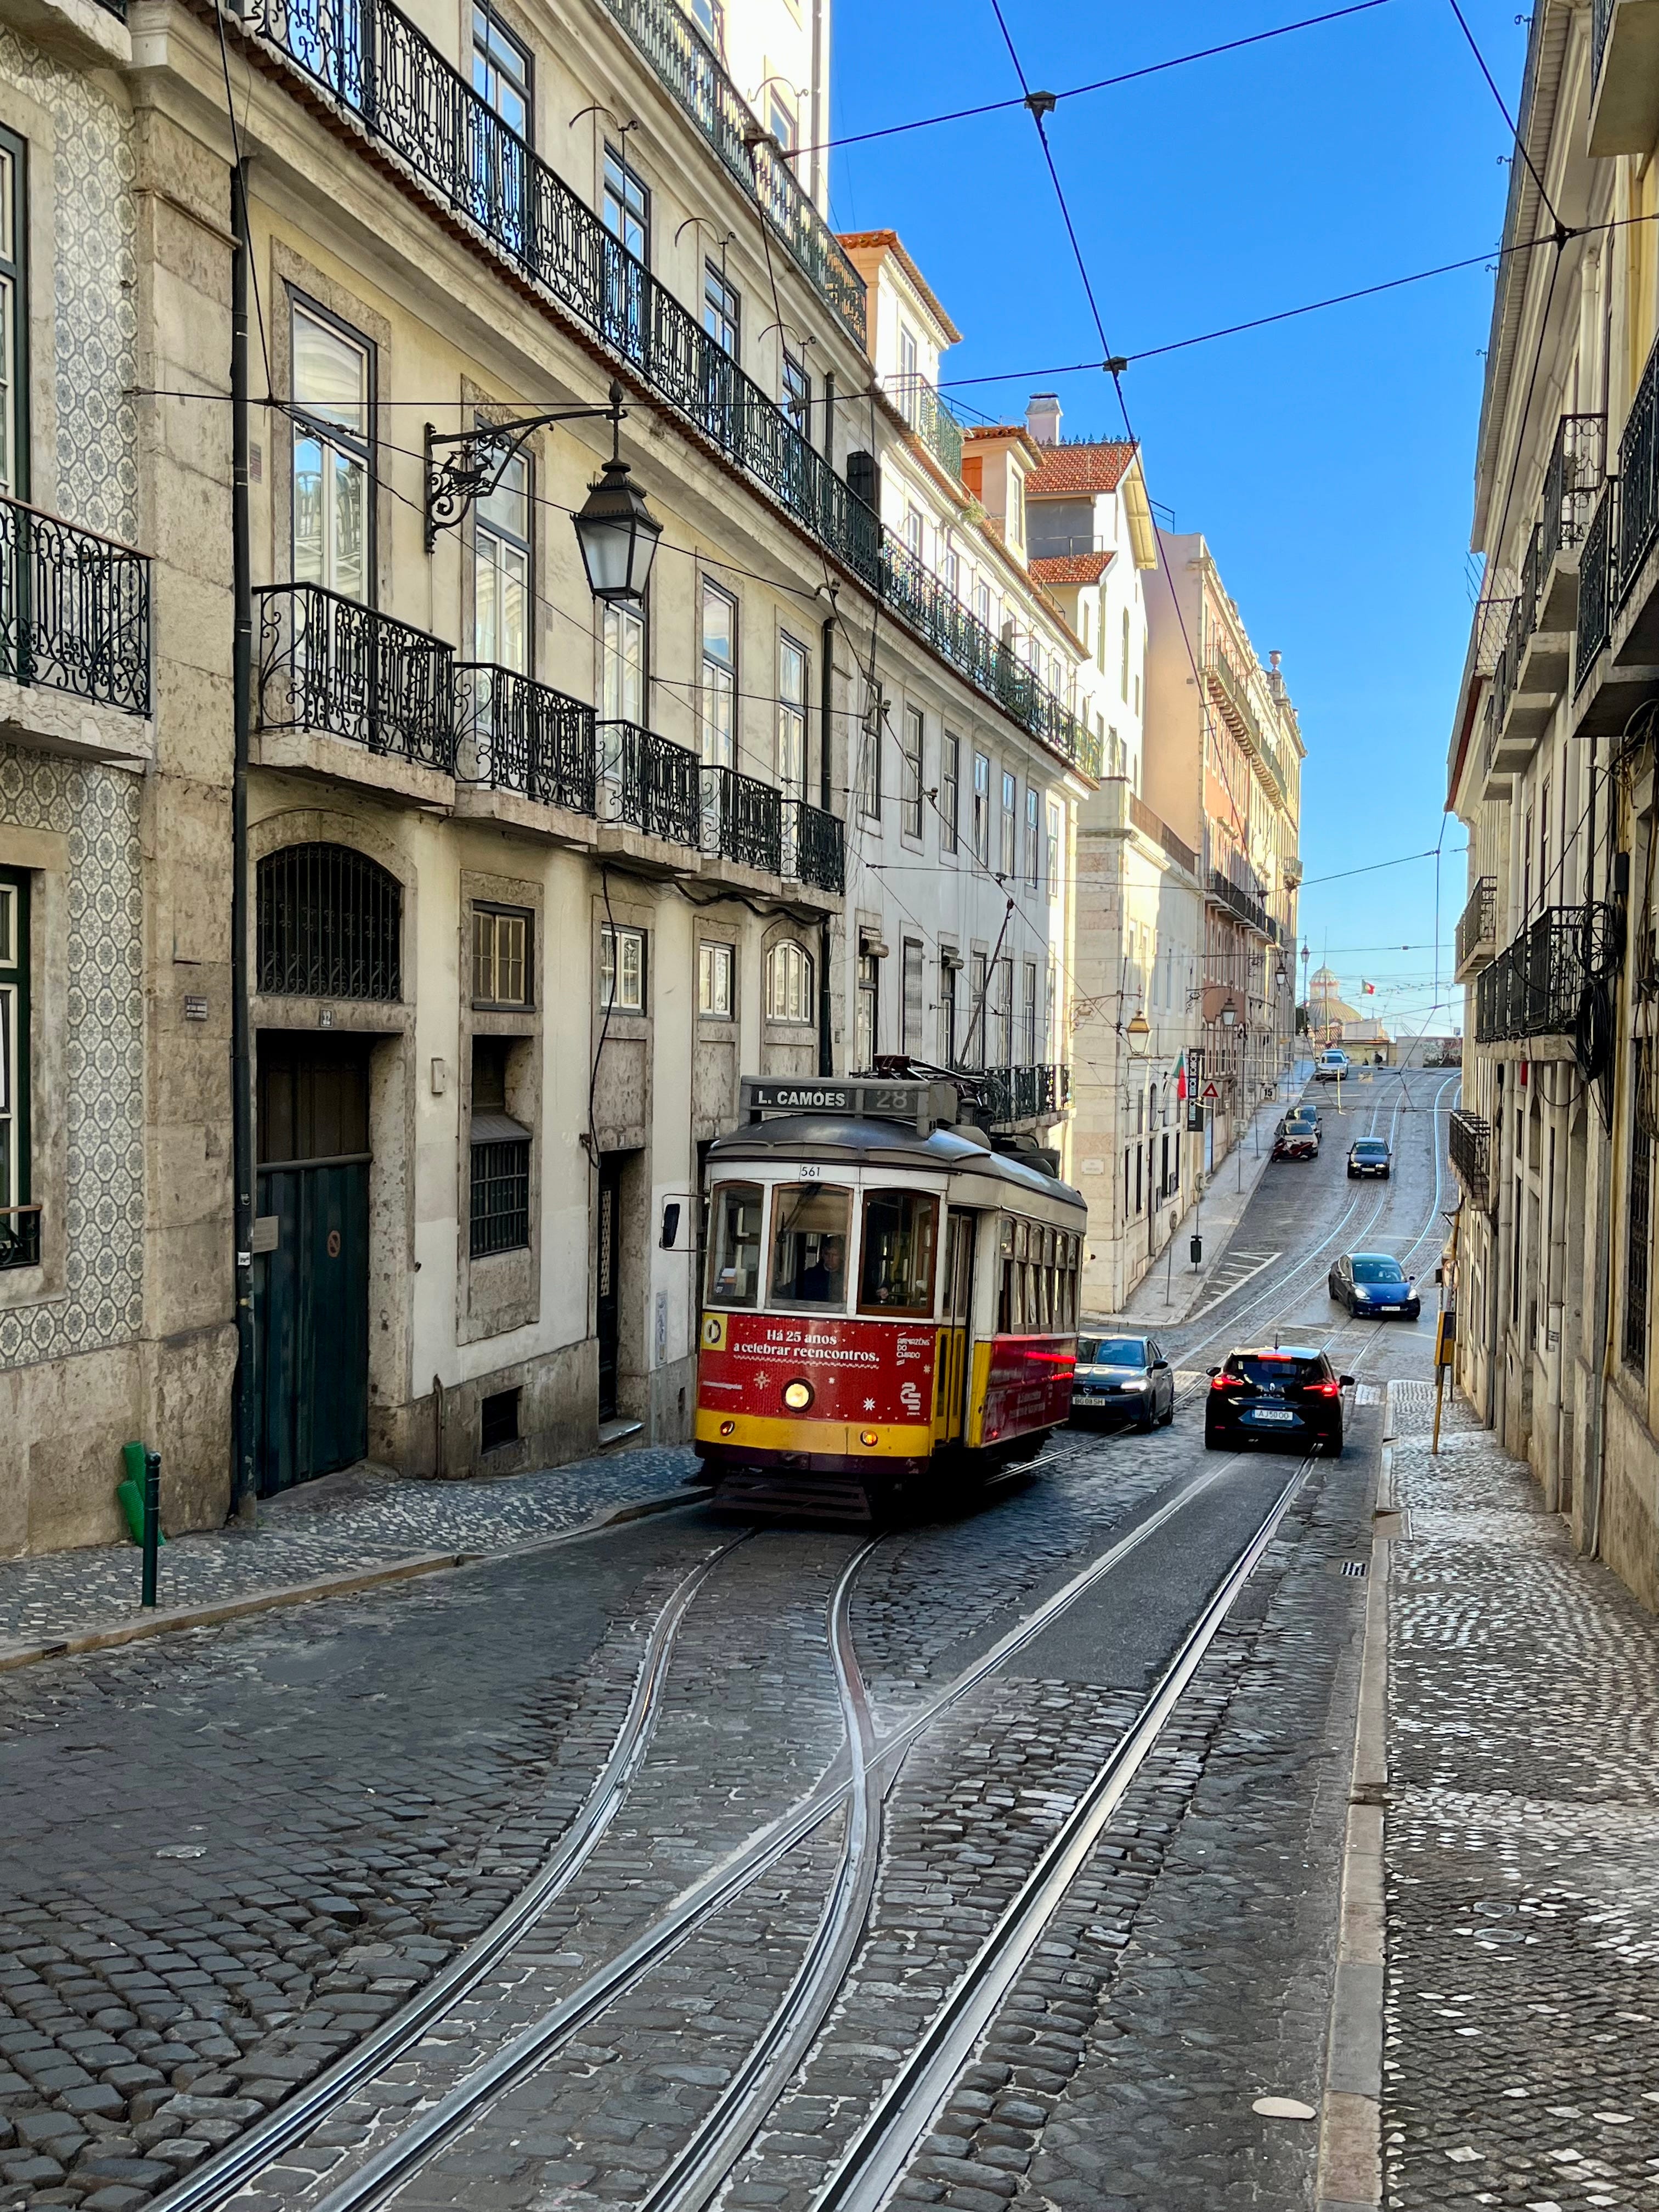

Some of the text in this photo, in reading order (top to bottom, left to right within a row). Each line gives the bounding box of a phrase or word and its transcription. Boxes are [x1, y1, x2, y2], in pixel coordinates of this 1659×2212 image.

[758, 1090, 771, 1104] L.
[877, 1090, 907, 1109] 28
[1264, 1088, 1272, 1097] 15
[801, 1166, 820, 1177] 561
[767, 1329, 837, 1345] Há 25 anos
[733, 1342, 879, 1362] a celebrar reencontros.
